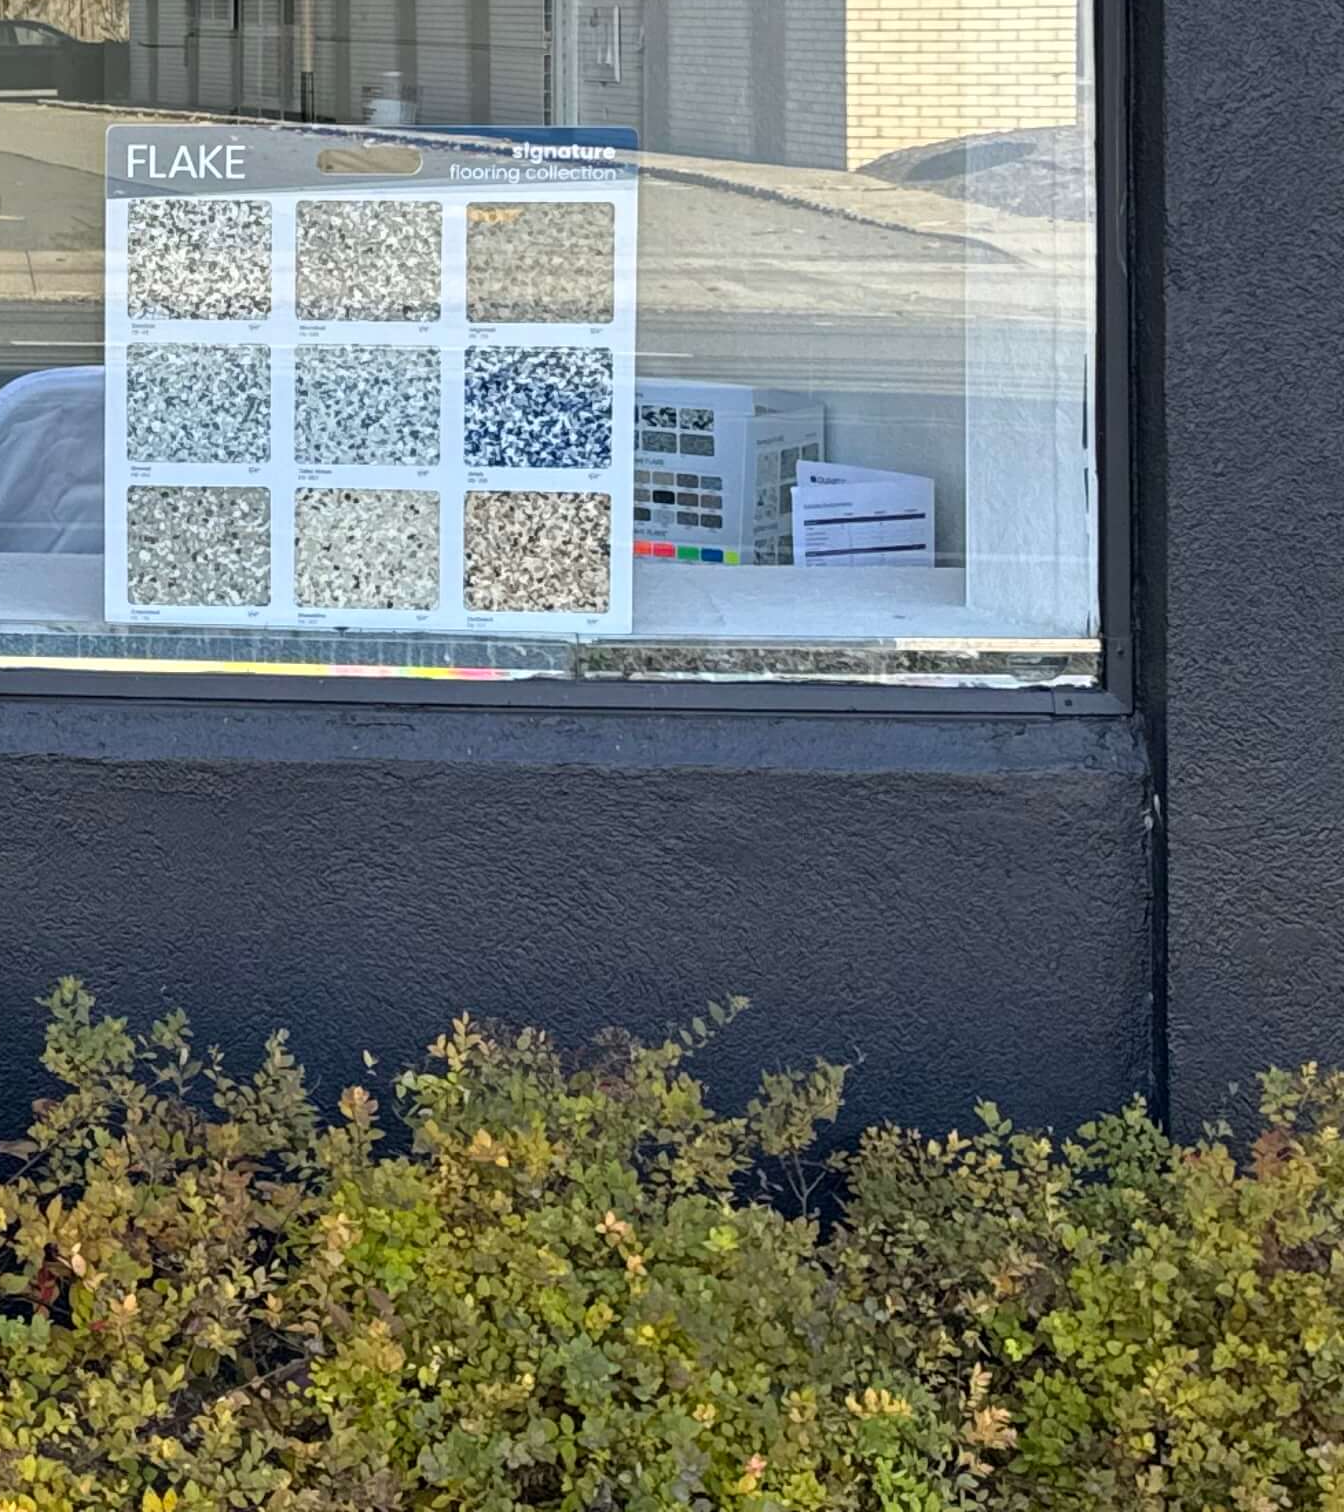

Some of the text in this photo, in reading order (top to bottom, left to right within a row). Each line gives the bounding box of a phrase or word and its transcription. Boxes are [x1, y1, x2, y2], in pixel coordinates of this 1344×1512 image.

[127, 144, 246, 179] FLAKE
[512, 142, 616, 165] signature
[449, 164, 617, 184] flooring collection
